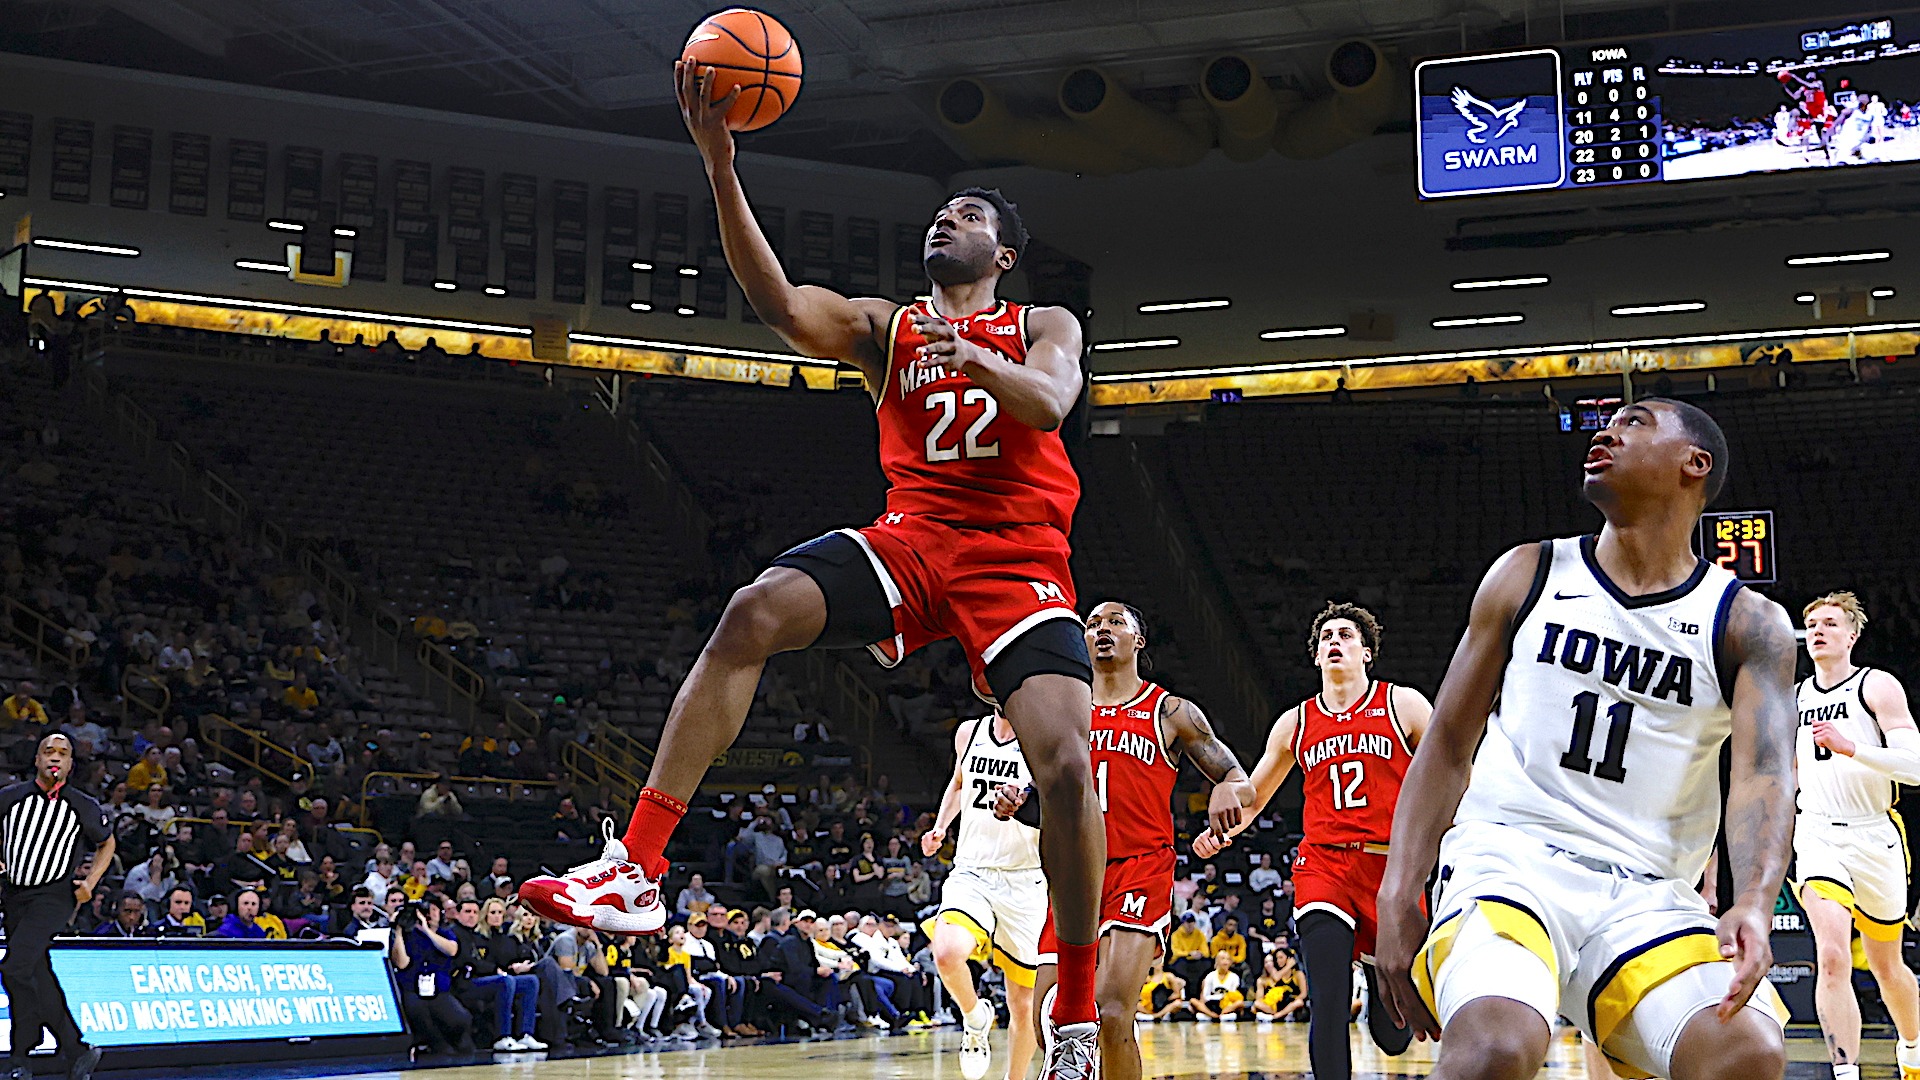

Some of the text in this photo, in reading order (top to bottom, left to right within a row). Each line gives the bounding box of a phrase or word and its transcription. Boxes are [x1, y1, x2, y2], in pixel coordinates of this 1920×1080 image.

[1592, 48, 1627, 61] IOWA
[1574, 66, 1646, 86] PLY PTS FL
[1577, 86, 1647, 105] 0 0 0
[1575, 105, 1647, 125] 11 4 0
[1575, 124, 1648, 144] 20 2 1
[1444, 144, 1537, 170] SWARM
[1575, 143, 1649, 163] 22 0 0
[1576, 163, 1650, 183] 23 0 0
[925, 388, 999, 463] 22
[1716, 518, 1766, 541] 12:33
[1716, 541, 1763, 575] 27
[1028, 581, 1068, 604] M
[1536, 621, 1694, 707] IOWA
[1088, 729, 1156, 766] RYLAND
[1559, 690, 1636, 785] 11
[1303, 732, 1393, 773] MARYLAND
[969, 755, 1020, 780] IOWA
[1095, 760, 1108, 812] 1
[1329, 760, 1368, 810] 12
[1120, 892, 1148, 920] M
[130, 963, 334, 996] EARN CASH, PERKS,
[80, 994, 389, 1033] AND MORE BANKING WITH FSB!
